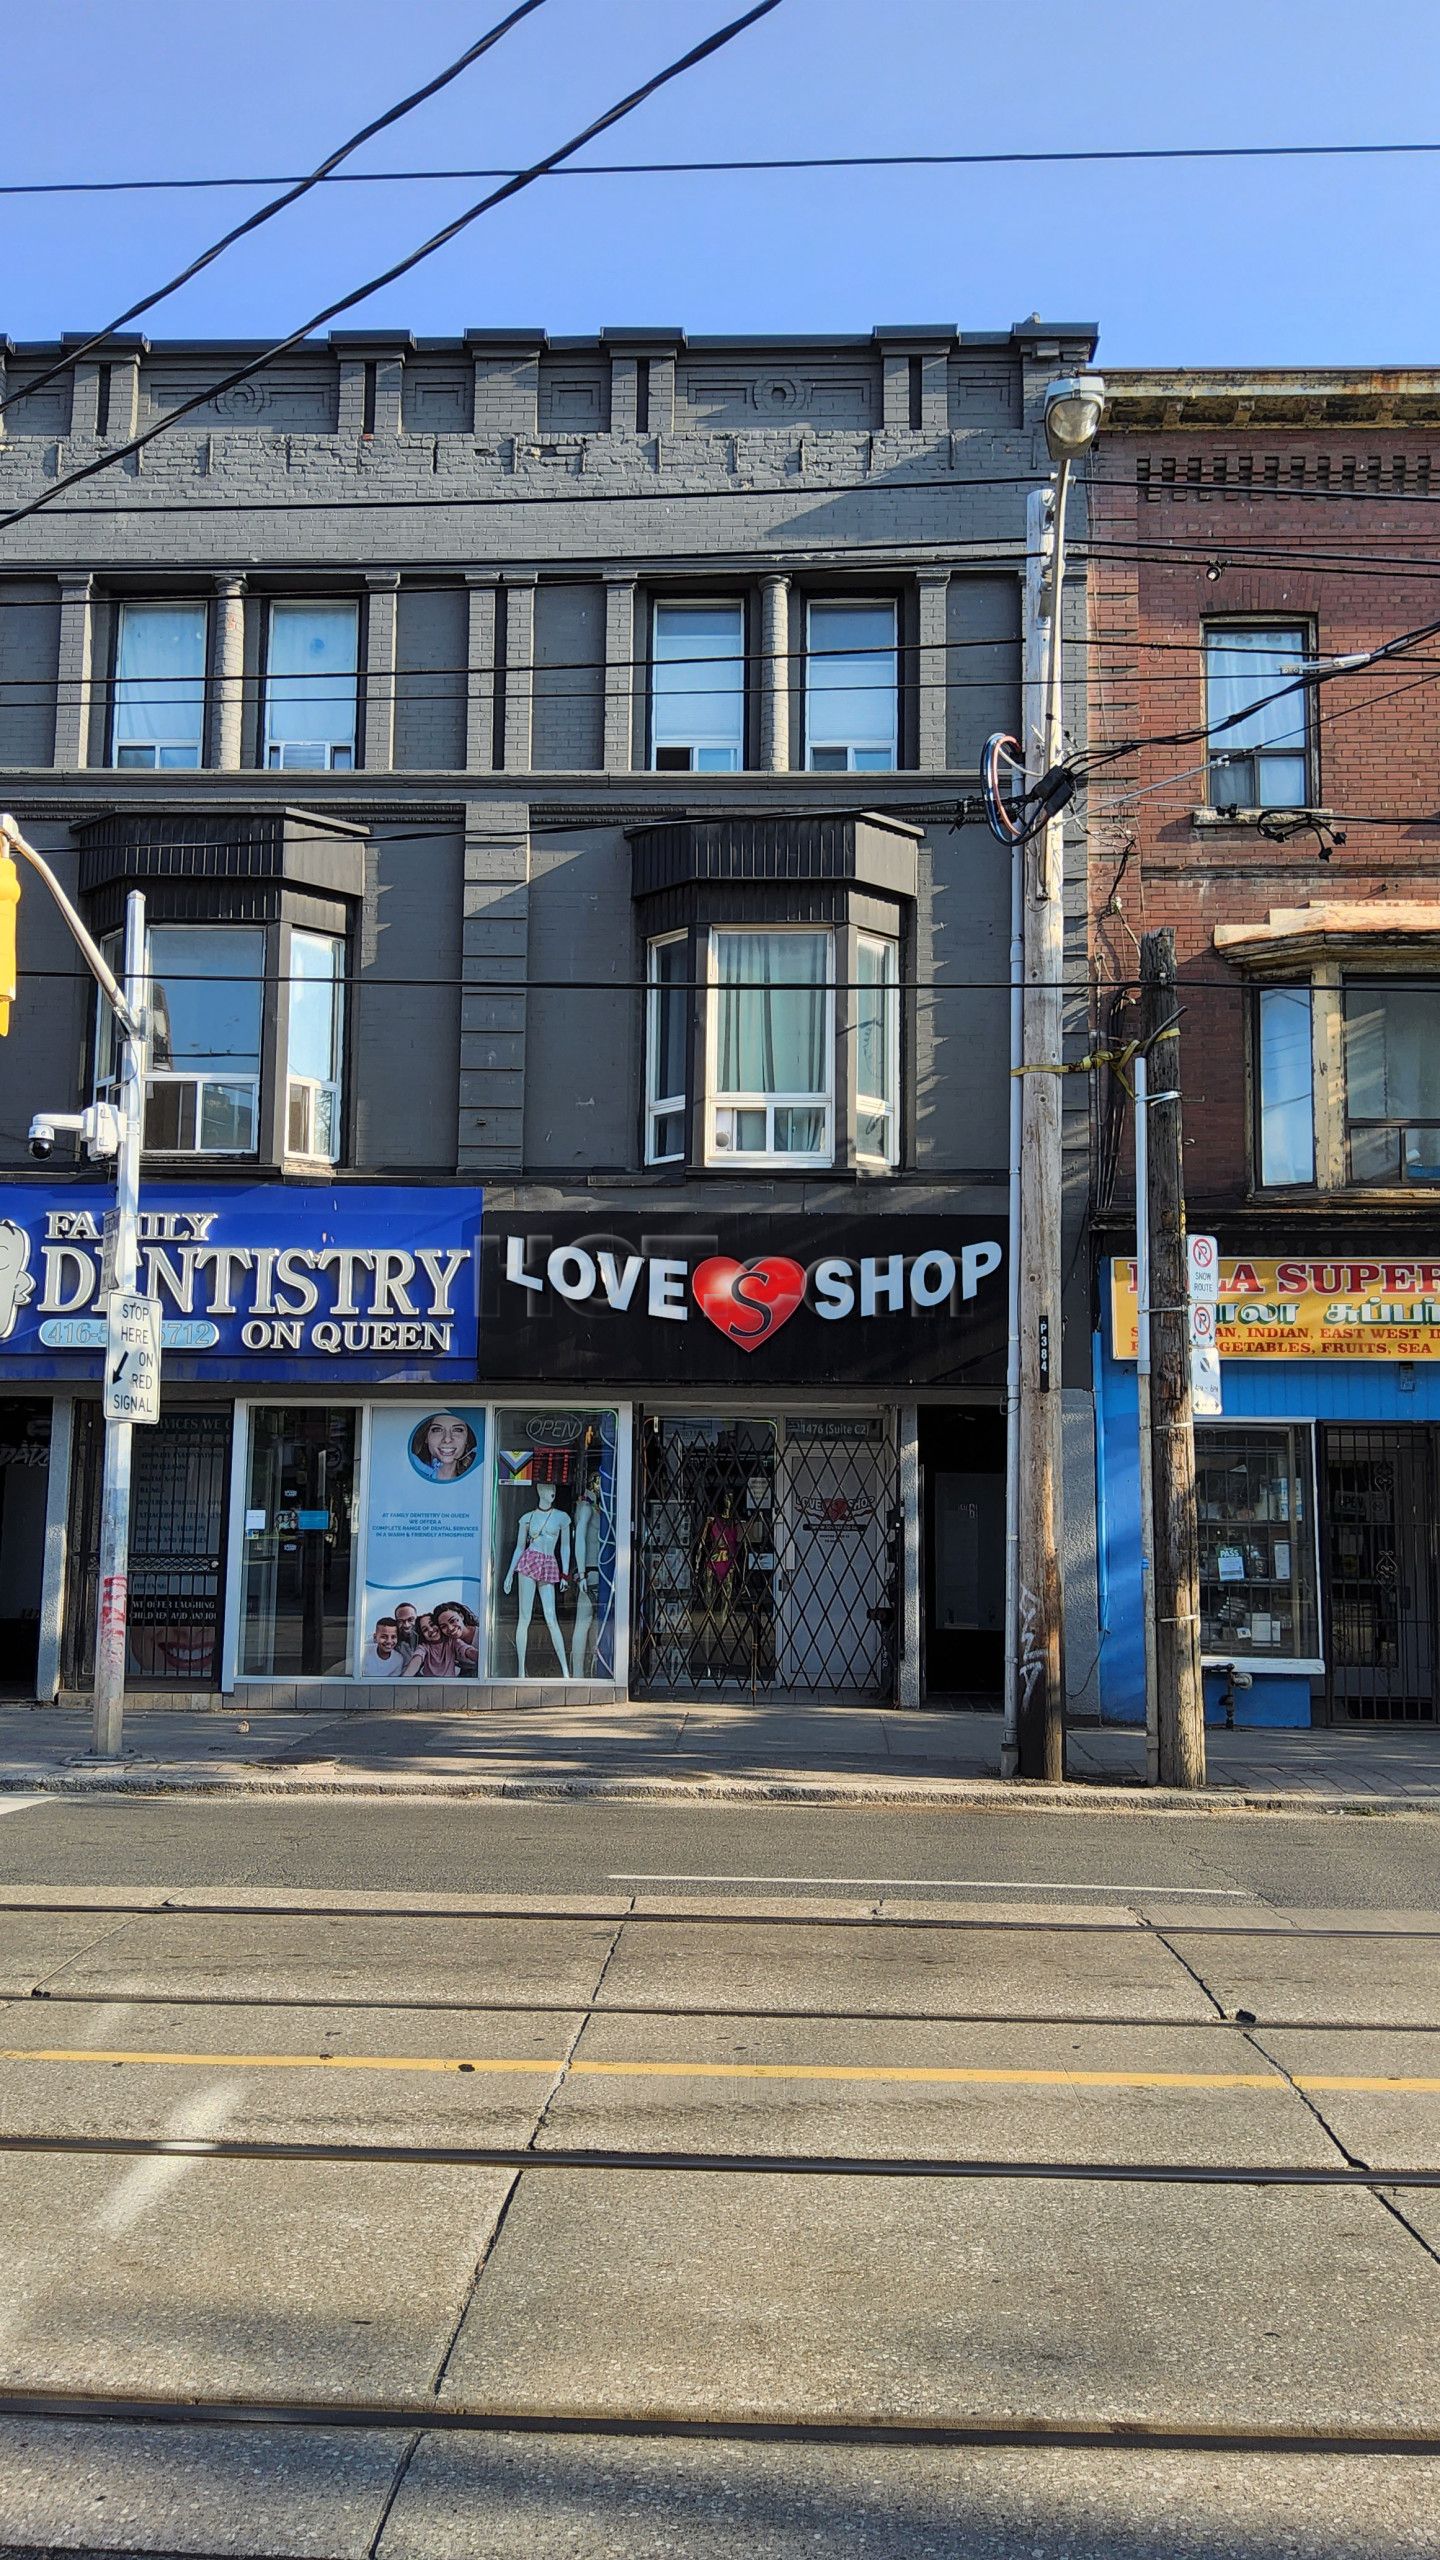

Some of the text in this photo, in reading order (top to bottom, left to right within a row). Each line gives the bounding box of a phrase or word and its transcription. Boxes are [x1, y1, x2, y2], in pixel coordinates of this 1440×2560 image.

[37, 1246, 471, 1315] DNTISTRY
[506, 1236, 688, 1320] LOVE
[815, 1241, 1003, 1320] SHOP
[1195, 1272, 1211, 1280] SNOW
[1194, 1283, 1213, 1293] ROUTE
[122, 1303, 149, 1321] STOP
[121, 1326, 149, 1344] HERE
[241, 1320, 454, 1353] ON QUEEN
[1247, 1327, 1314, 1339] INDIAN,
[1320, 1328, 1366, 1339] EAST
[1370, 1328, 1421, 1339] WEST
[1321, 1342, 1391, 1354] FRUITS,
[1397, 1343, 1432, 1354] SEA
[139, 1352, 153, 1367] ON
[132, 1373, 152, 1389] RED
[113, 1394, 152, 1413] SIGNAL
[530, 1420, 577, 1437] OPEN
[802, 1424, 823, 1434] 1476
[825, 1424, 852, 1435] (Suite
